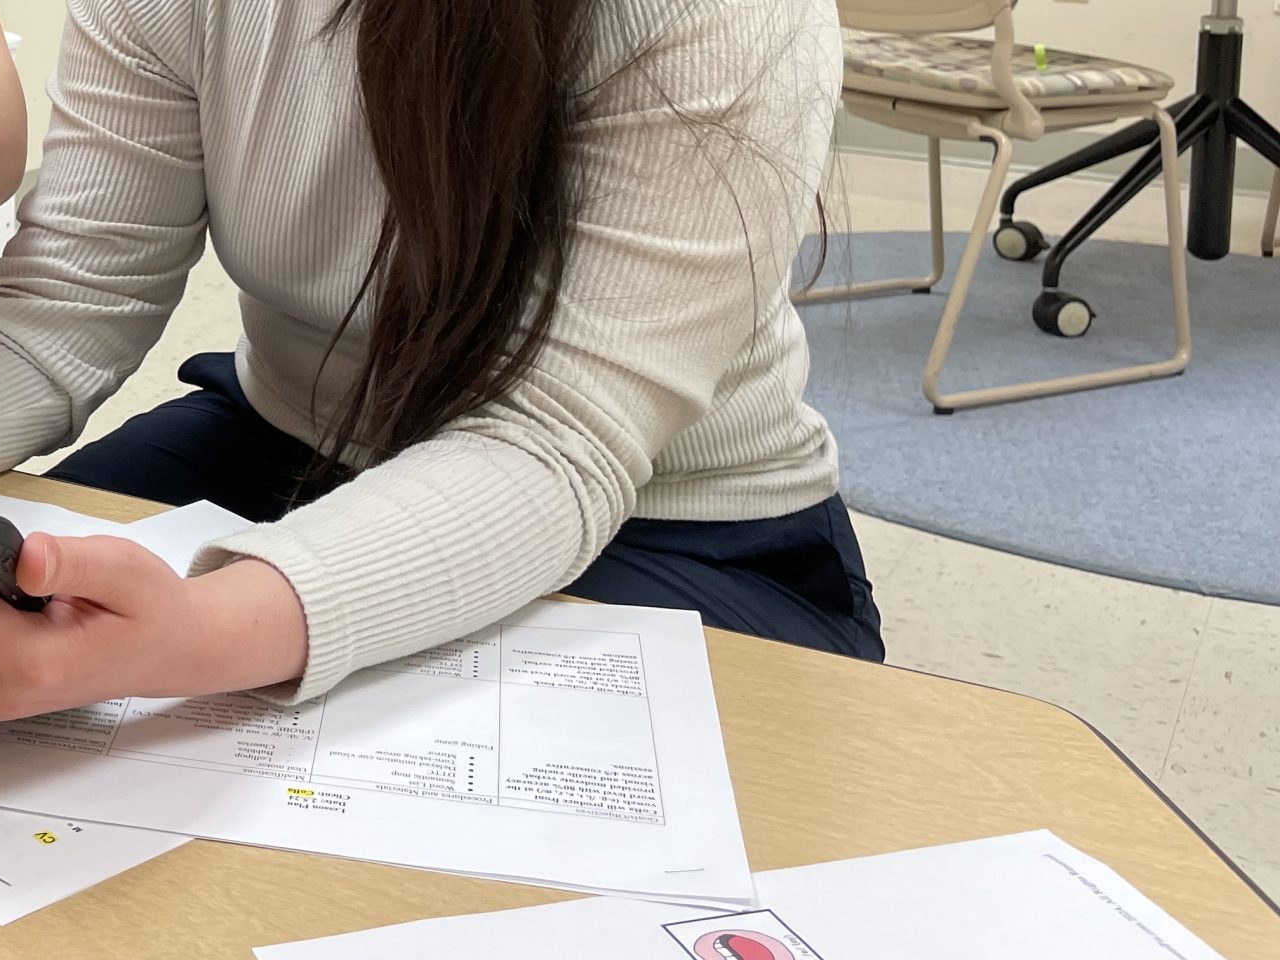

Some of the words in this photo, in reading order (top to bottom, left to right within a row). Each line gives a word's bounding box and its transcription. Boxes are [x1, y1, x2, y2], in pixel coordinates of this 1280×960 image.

[511, 649, 560, 657] consecutive
[576, 669, 615, 677] accuracy
[557, 682, 593, 690] produce
[192, 723, 232, 731] inventory
[277, 726, 314, 734] (PROBE
[236, 740, 275, 749] Cheerios
[460, 741, 493, 750] Fishing
[237, 747, 273, 755] Bubbles
[328, 750, 355, 758] visual
[427, 750, 456, 758] Mirror
[233, 752, 272, 762] Lollipop
[375, 756, 415, 765] imitation
[403, 753, 455, 764] Turn-taking
[418, 761, 455, 771] Delayed
[545, 762, 601, 774] consecutive
[242, 768, 304, 781] Modifications
[390, 770, 410, 778] map
[426, 769, 455, 777] DTTC
[532, 767, 563, 776] cueing
[566, 771, 596, 780] tactile
[621, 772, 652, 780] across
[413, 774, 455, 784] Semantic
[505, 777, 549, 787] accuracy
[559, 777, 606, 788] moderate
[375, 784, 418, 794] Materials
[578, 786, 599, 794] with
[609, 783, 654, 794] provided
[318, 791, 350, 800] Client:
[441, 792, 491, 803] Procedures
[629, 793, 655, 801] word
[287, 801, 308, 809] Plan
[320, 799, 346, 807] Date:
[562, 798, 603, 808] produce
[622, 799, 656, 807] vowels
[313, 804, 345, 813] Lesson
[34, 832, 56, 844] CV
